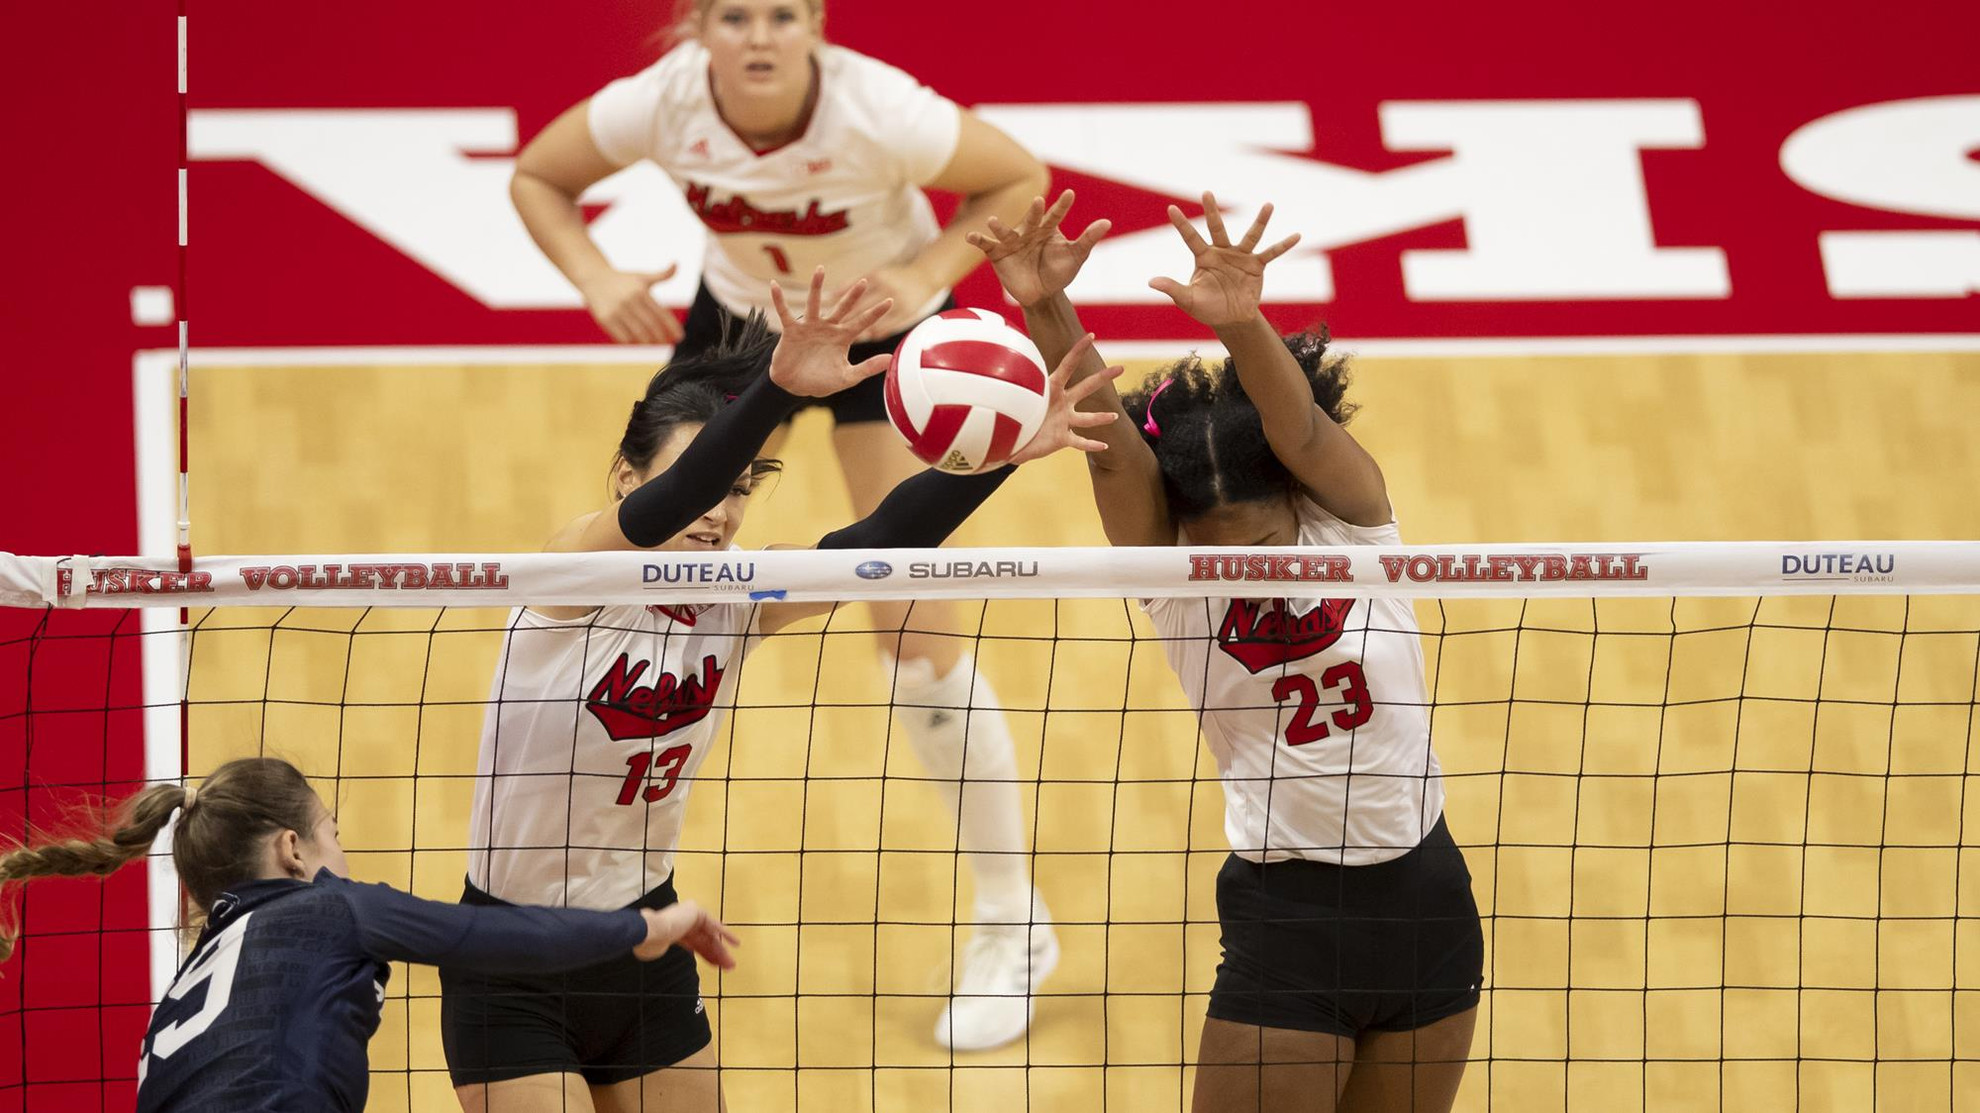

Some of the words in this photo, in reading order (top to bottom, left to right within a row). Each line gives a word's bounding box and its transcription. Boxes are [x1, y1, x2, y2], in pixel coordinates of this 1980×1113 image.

[763, 243, 792, 275] 1
[239, 562, 509, 590] VOLLEYBALL
[642, 562, 755, 583] DUTEAU
[909, 561, 1038, 579] SUBARU
[1188, 553, 1354, 582] HUSKER
[1378, 554, 1649, 583] VOLLEYBALL
[1781, 553, 1895, 575] DUTEAU
[713, 584, 755, 592] SUBARU
[1853, 575, 1895, 583] SUBARU
[1271, 660, 1374, 747] 23
[615, 743, 693, 806] 13
